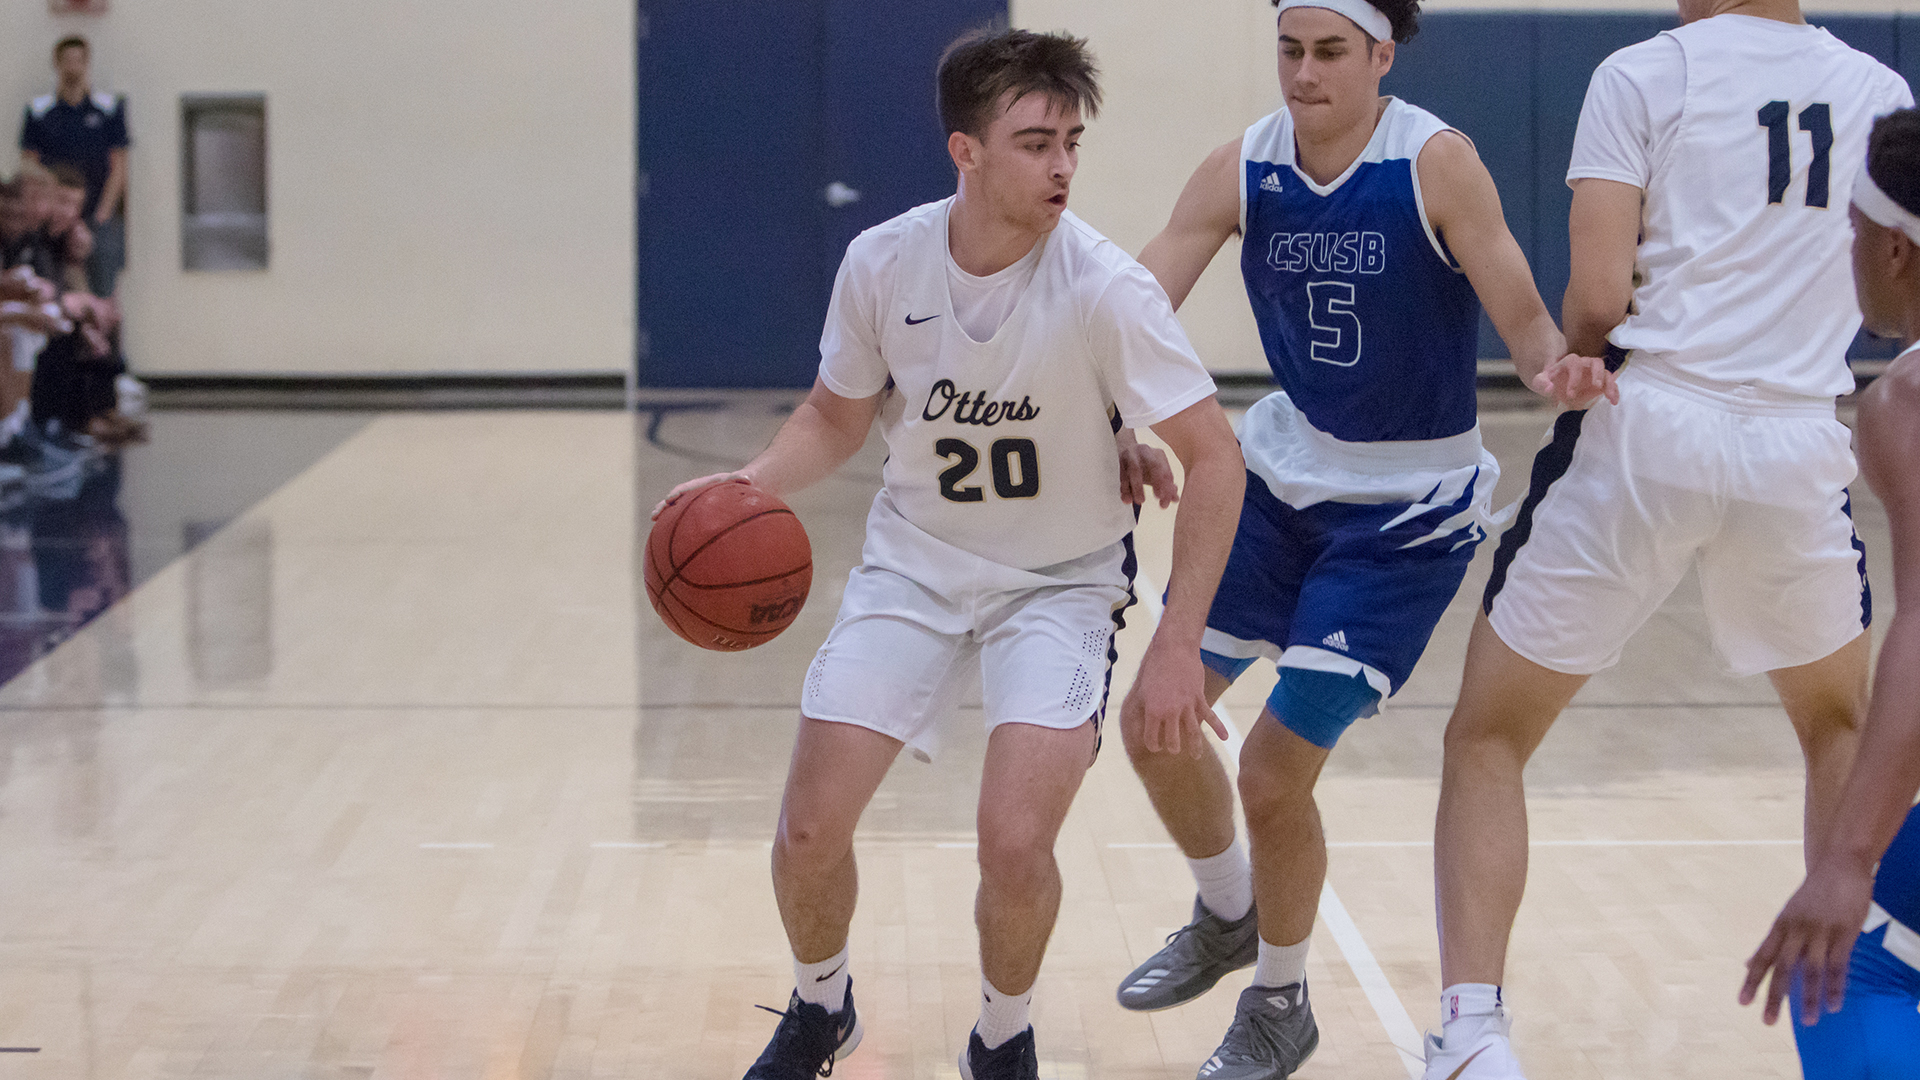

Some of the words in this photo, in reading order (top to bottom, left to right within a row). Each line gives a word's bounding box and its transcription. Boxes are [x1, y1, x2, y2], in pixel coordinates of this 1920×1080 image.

[1757, 100, 1834, 209] 11
[1267, 231, 1385, 274] CSUSB
[1307, 281, 1361, 367] 5
[922, 378, 1041, 427] Otters
[933, 437, 1042, 503] 20
